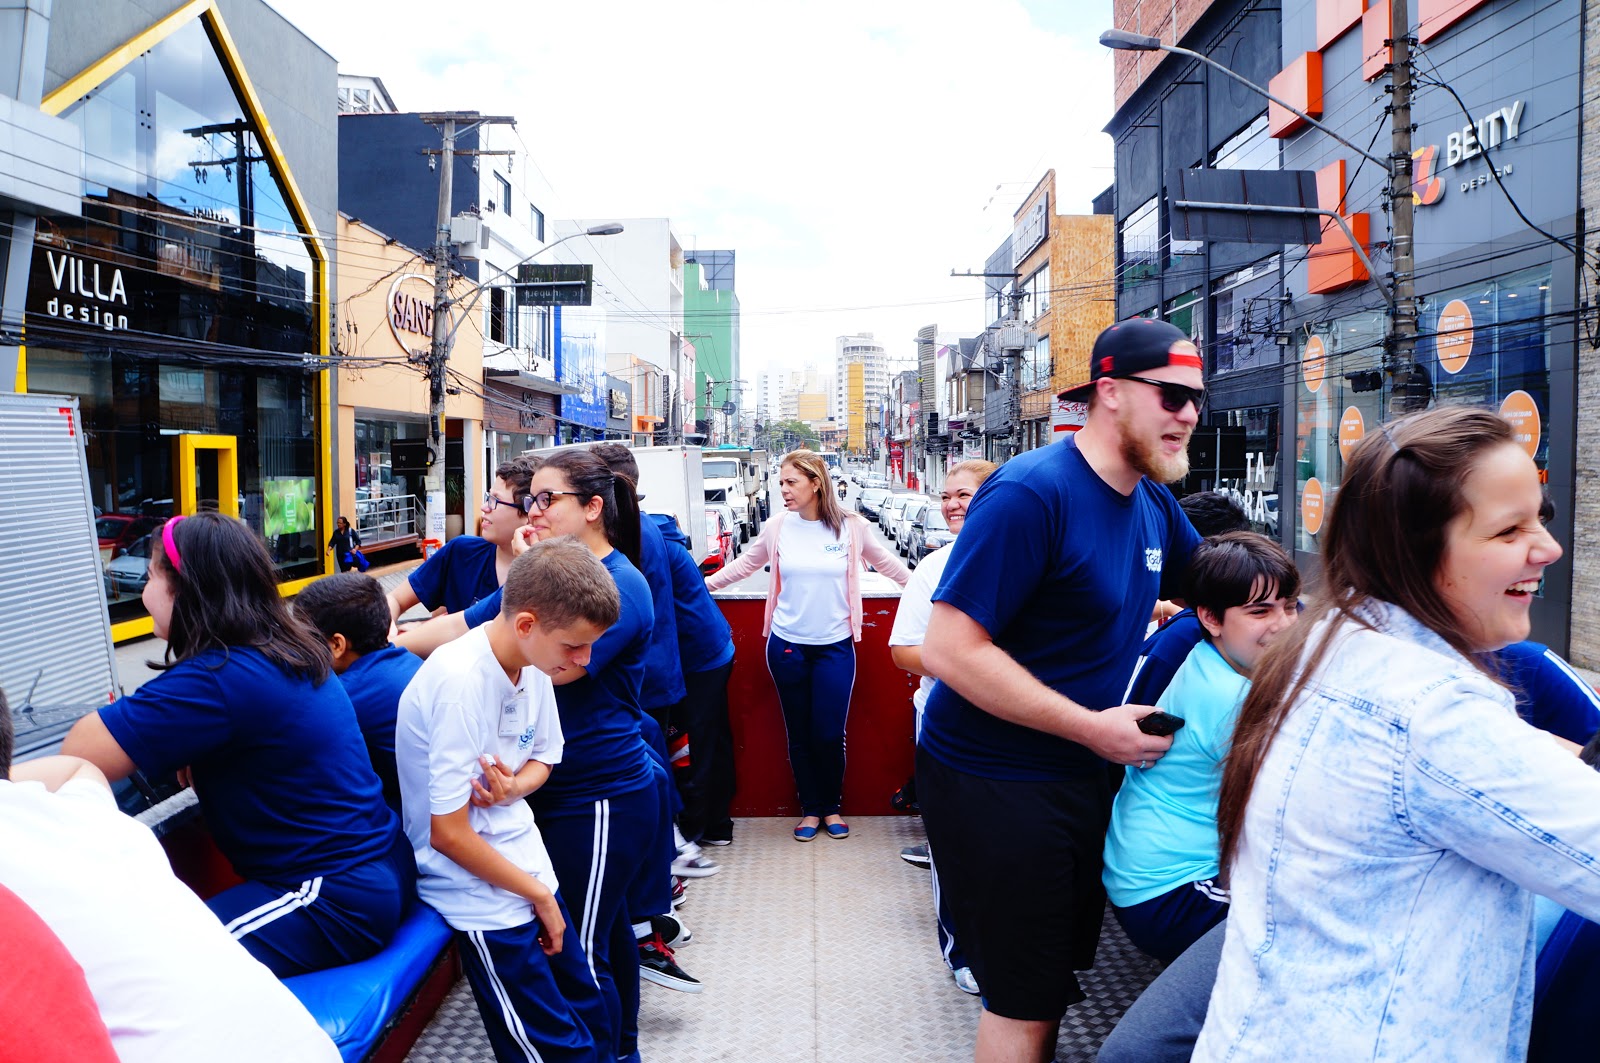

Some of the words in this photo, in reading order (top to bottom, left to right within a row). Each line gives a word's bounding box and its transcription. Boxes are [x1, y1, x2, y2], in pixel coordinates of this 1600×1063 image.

[1447, 100, 1526, 168] BEITY
[1460, 164, 1513, 193] DESIGN
[46, 250, 128, 306] VILLA
[47, 297, 128, 331] design
